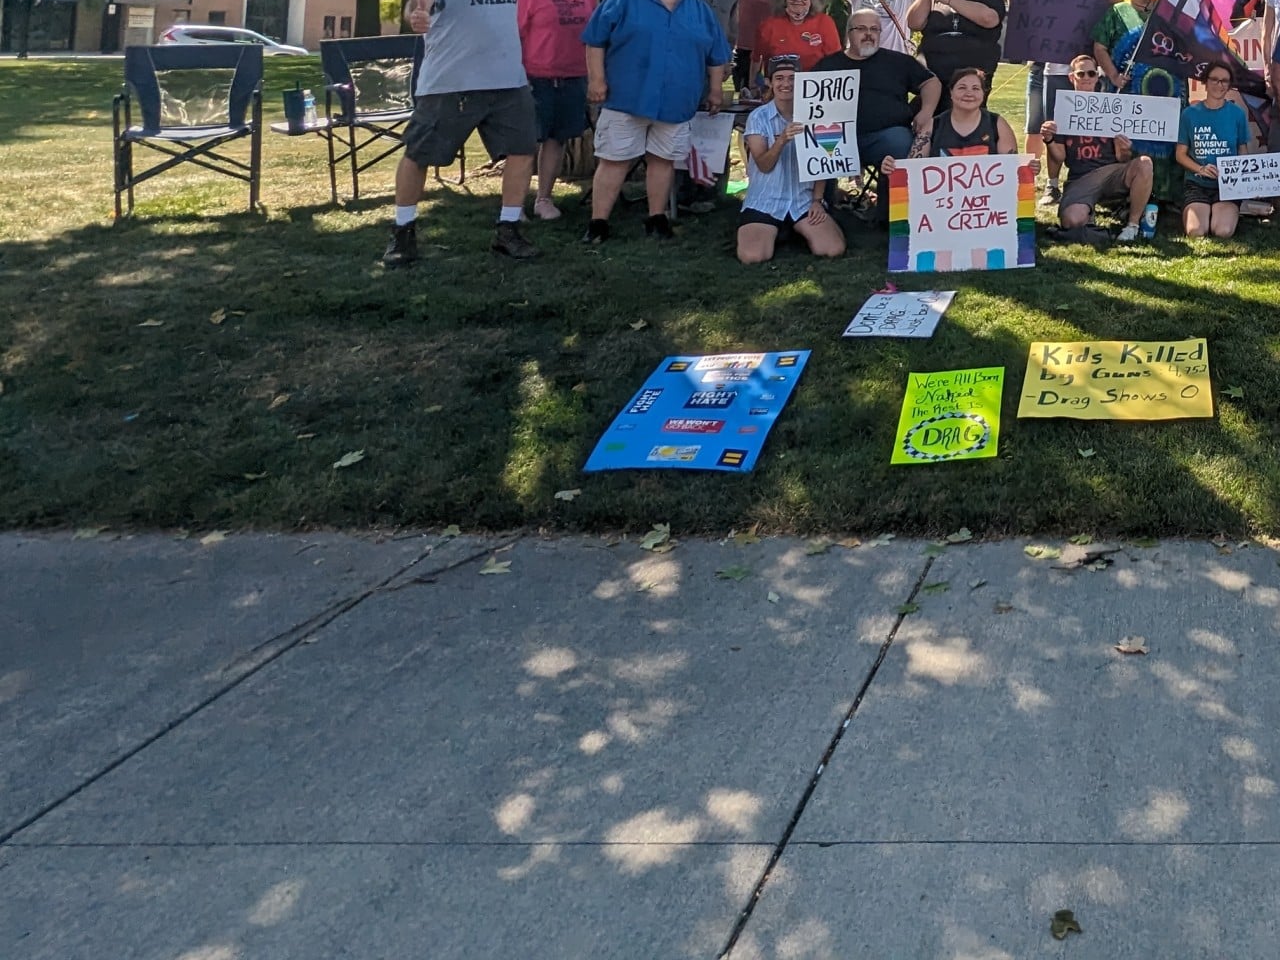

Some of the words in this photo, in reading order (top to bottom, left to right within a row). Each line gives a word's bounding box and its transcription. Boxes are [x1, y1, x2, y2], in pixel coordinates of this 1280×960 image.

[1016, 13, 1057, 30] NOT
[803, 76, 855, 101] DRAG
[809, 102, 824, 120] is
[1074, 95, 1122, 114] DRAG
[1132, 101, 1143, 115] is
[1069, 115, 1103, 131] FREE
[1110, 117, 1166, 136] SPEECH
[807, 157, 856, 176] CRIME
[1241, 159, 1259, 173] 23
[1261, 159, 1278, 168] kids
[922, 162, 1005, 194] DRAG
[1221, 176, 1239, 187] Why
[935, 197, 953, 209] IS
[961, 195, 991, 210] NOT
[918, 214, 933, 233] A
[948, 211, 1008, 230] CRIME
[1042, 345, 1103, 366] Kids
[915, 375, 949, 388] We're
[954, 372, 971, 386] All
[630, 390, 653, 412] FIGHT
[640, 390, 661, 411] HATE
[916, 388, 979, 404] Naked
[1100, 389, 1168, 407] Shows
[922, 425, 980, 450] DRAG
